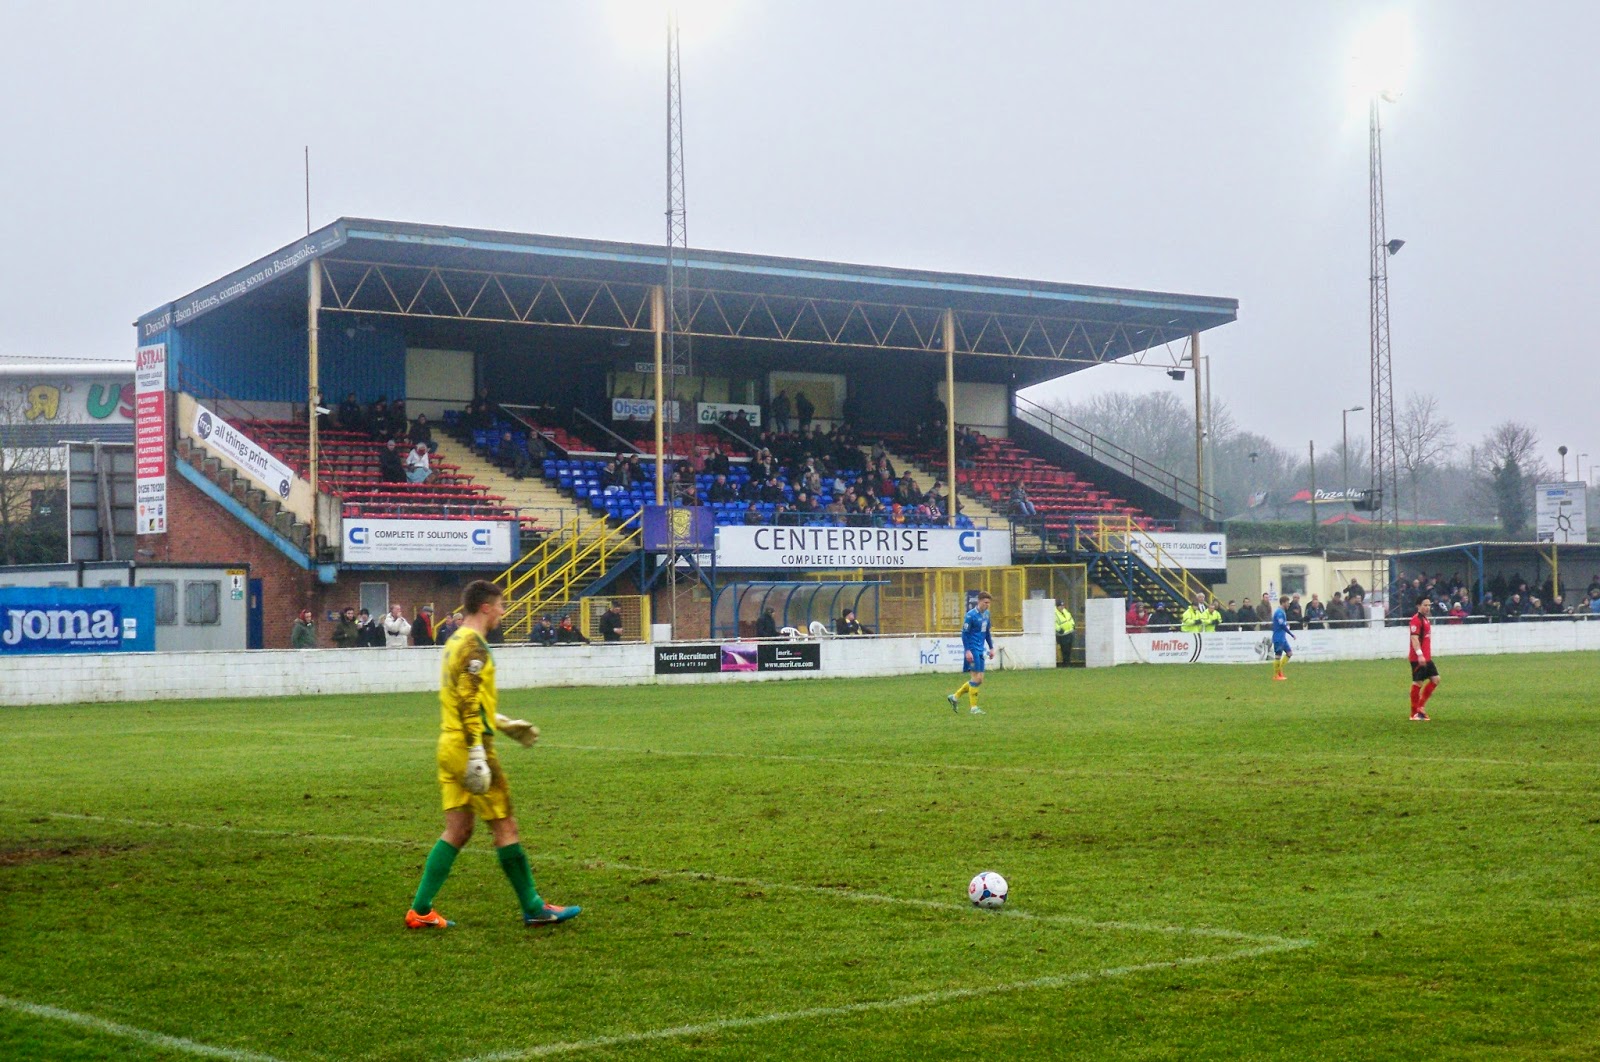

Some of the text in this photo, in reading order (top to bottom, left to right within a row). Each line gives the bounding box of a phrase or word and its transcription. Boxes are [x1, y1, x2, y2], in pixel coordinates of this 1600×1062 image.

[145, 316, 164, 336] David
[163, 306, 192, 326] Wilson
[192, 296, 220, 314] Homes,
[219, 280, 246, 300] coming
[246, 272, 264, 288] soon
[264, 266, 274, 278] to
[273, 243, 318, 272] Basingstoke.
[136, 348, 164, 370] ASTRAL
[138, 396, 158, 404] PLUMBING
[138, 416, 162, 424] ELECTRICAL
[701, 410, 757, 423] GAZE
[139, 426, 162, 434] CARPENTRY
[139, 436, 163, 444] DECORATING
[214, 425, 268, 470] all things print
[139, 456, 162, 464] BATHROOMS
[1314, 488, 1344, 499] Pizza
[427, 531, 468, 540] SOLUTIONS
[754, 528, 929, 551] CENTERPRISE
[781, 554, 905, 565] COMPLETE IT SOLUTIONS
[1152, 640, 1188, 651] MiniTec
[660, 652, 716, 661] Merit Recruitment
[920, 650, 939, 664] hcr
